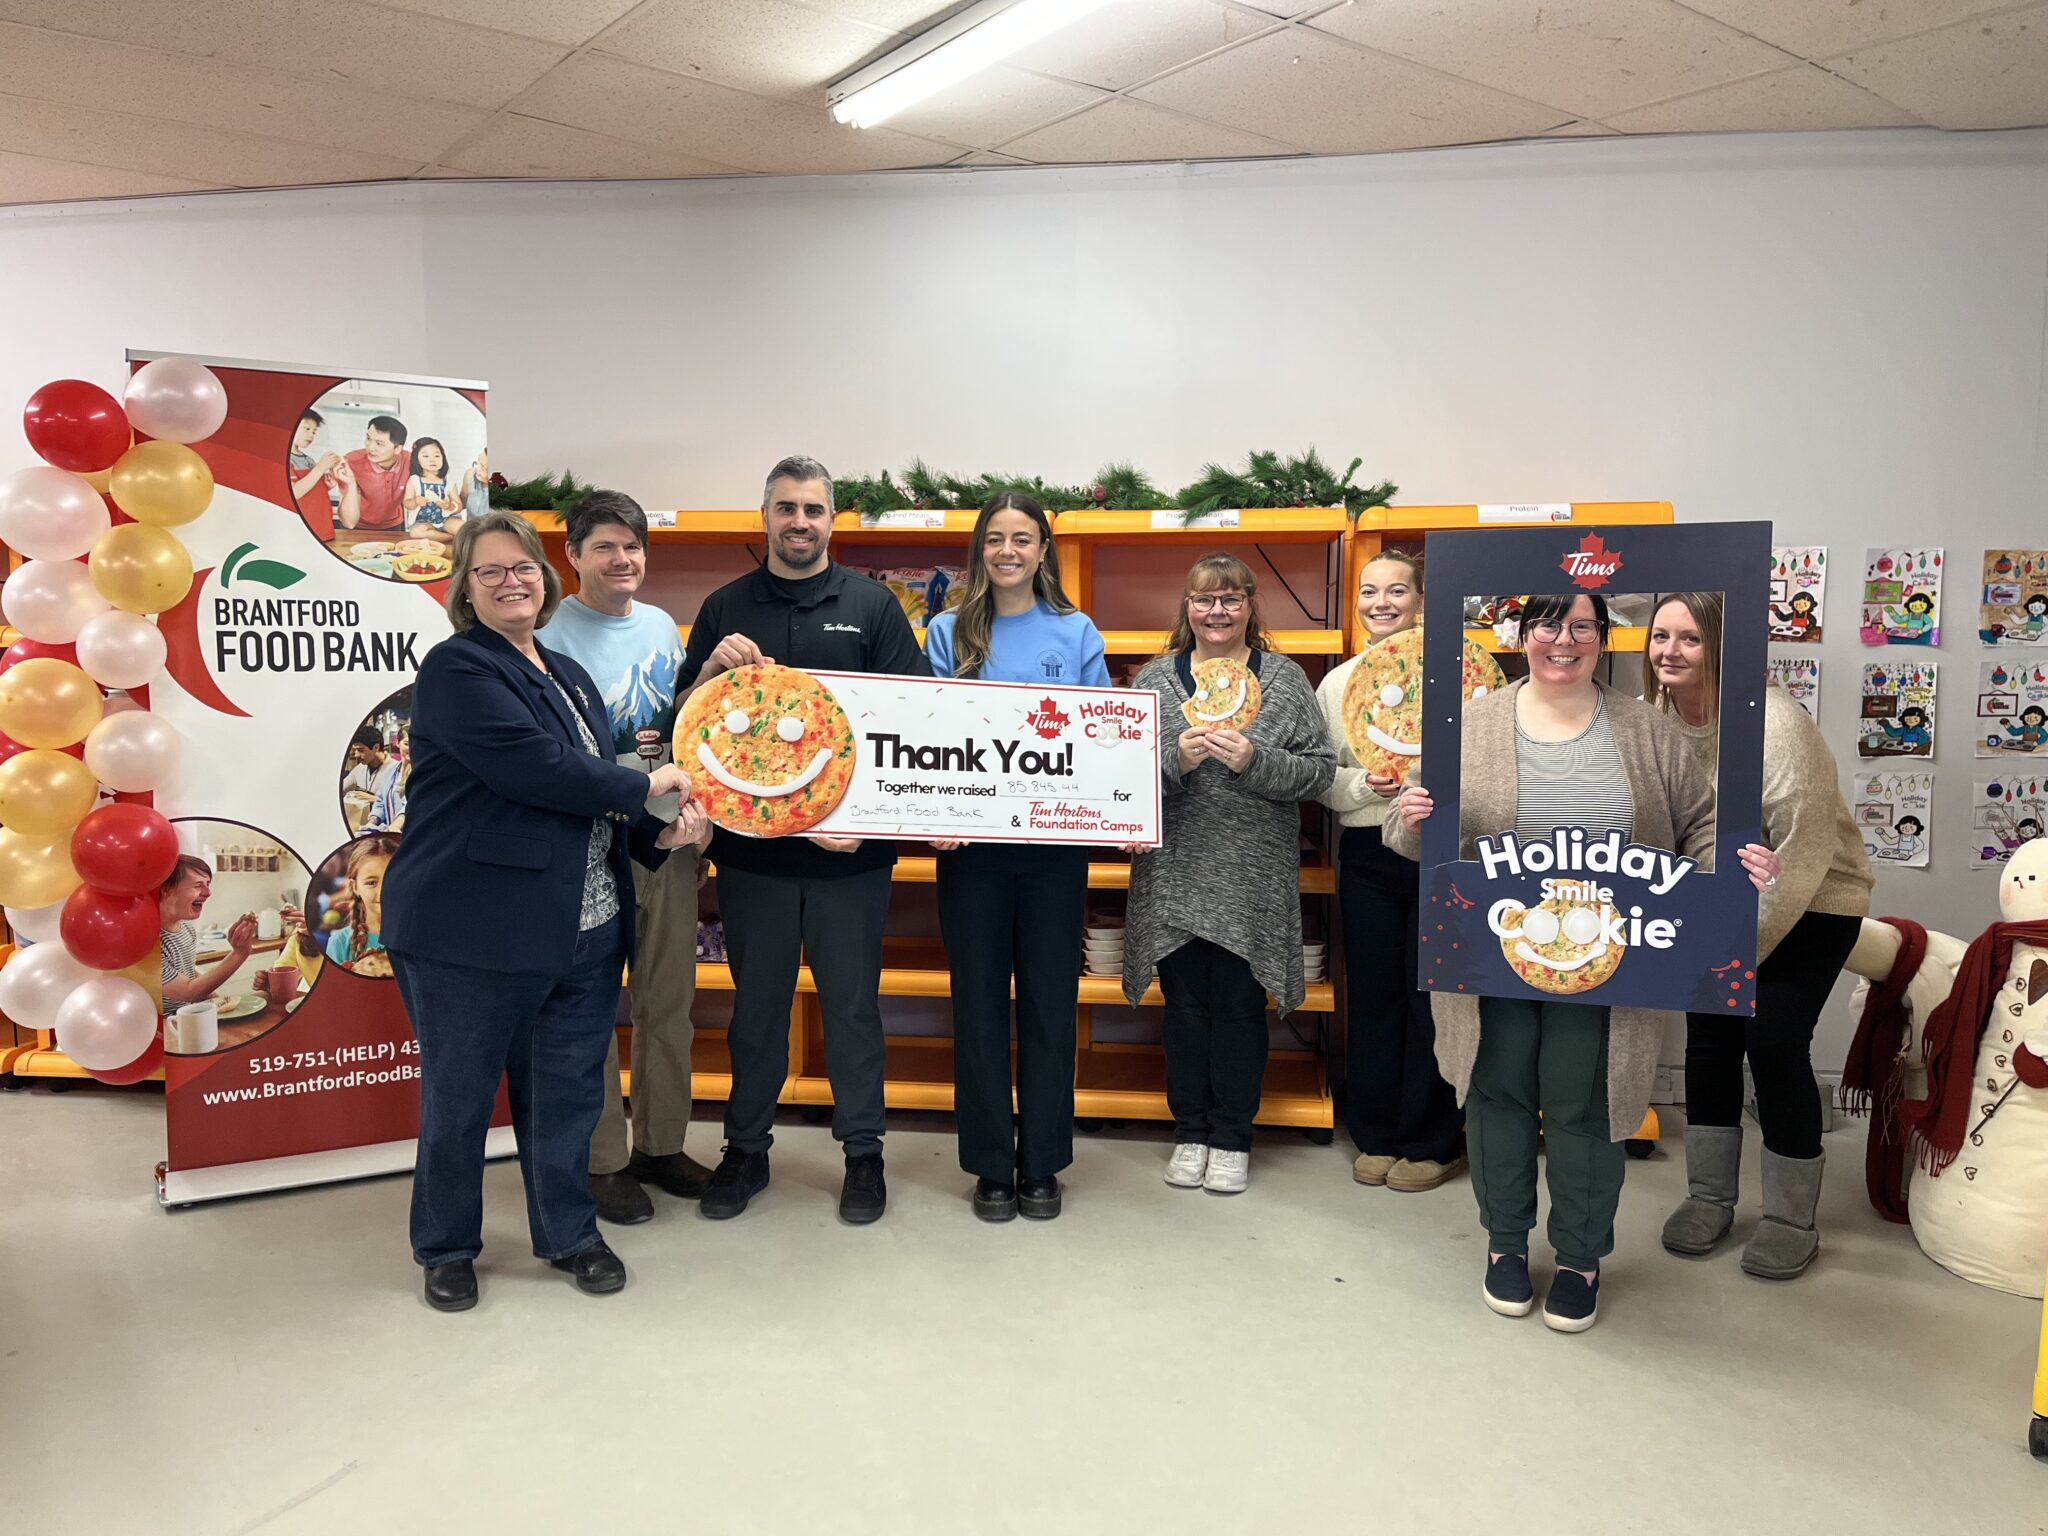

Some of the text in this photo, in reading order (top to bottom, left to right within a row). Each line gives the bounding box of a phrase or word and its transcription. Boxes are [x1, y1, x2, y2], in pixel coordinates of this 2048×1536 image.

[1567, 552, 1616, 576] Tims
[1911, 571, 1939, 579] Holiday
[214, 597, 360, 627] BRANTFORD
[822, 622, 862, 634] Tim Hortons
[216, 630, 421, 673] FOOD BANK
[1033, 711, 1067, 731] Tims
[1079, 700, 1148, 724] Holiday
[1101, 716, 1122, 724] Smile
[866, 732, 1074, 777] Thank You!
[876, 779, 936, 796] Together
[937, 786, 956, 796] we
[957, 784, 996, 797] raised
[1113, 789, 1133, 802] for
[906, 803, 940, 817] Food
[945, 805, 984, 818] Bank
[1011, 815, 1022, 828] &
[1029, 801, 1102, 819] Tim Hortons
[1029, 817, 1144, 835] Foundation Camps
[1478, 829, 1693, 895] Holiday
[1539, 878, 1614, 902] Smile
[249, 1041, 396, 1075] 519-751-(HELP)
